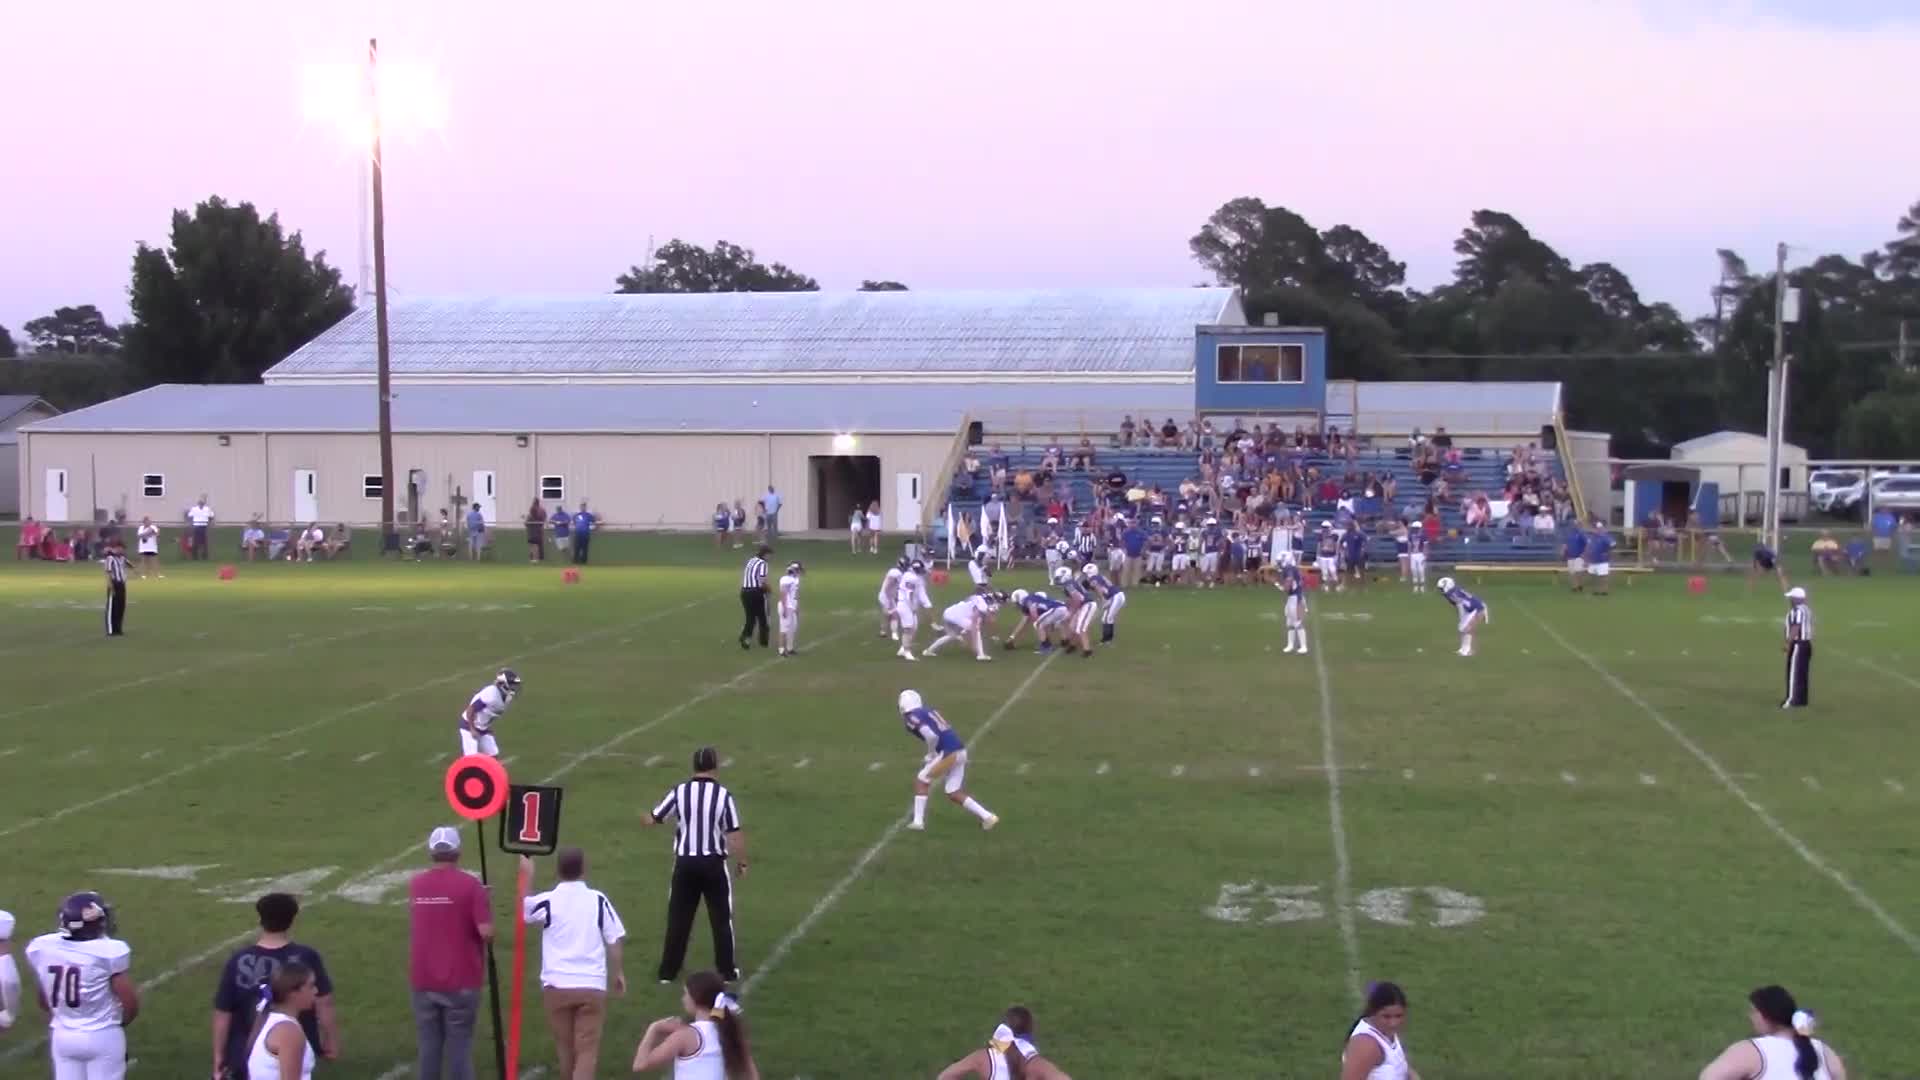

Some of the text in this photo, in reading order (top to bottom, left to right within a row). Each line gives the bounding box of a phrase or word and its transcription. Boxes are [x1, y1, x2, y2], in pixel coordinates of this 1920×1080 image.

[519, 791, 541, 842] 1
[1205, 880, 1488, 928] 50
[47, 964, 81, 1009] 70
